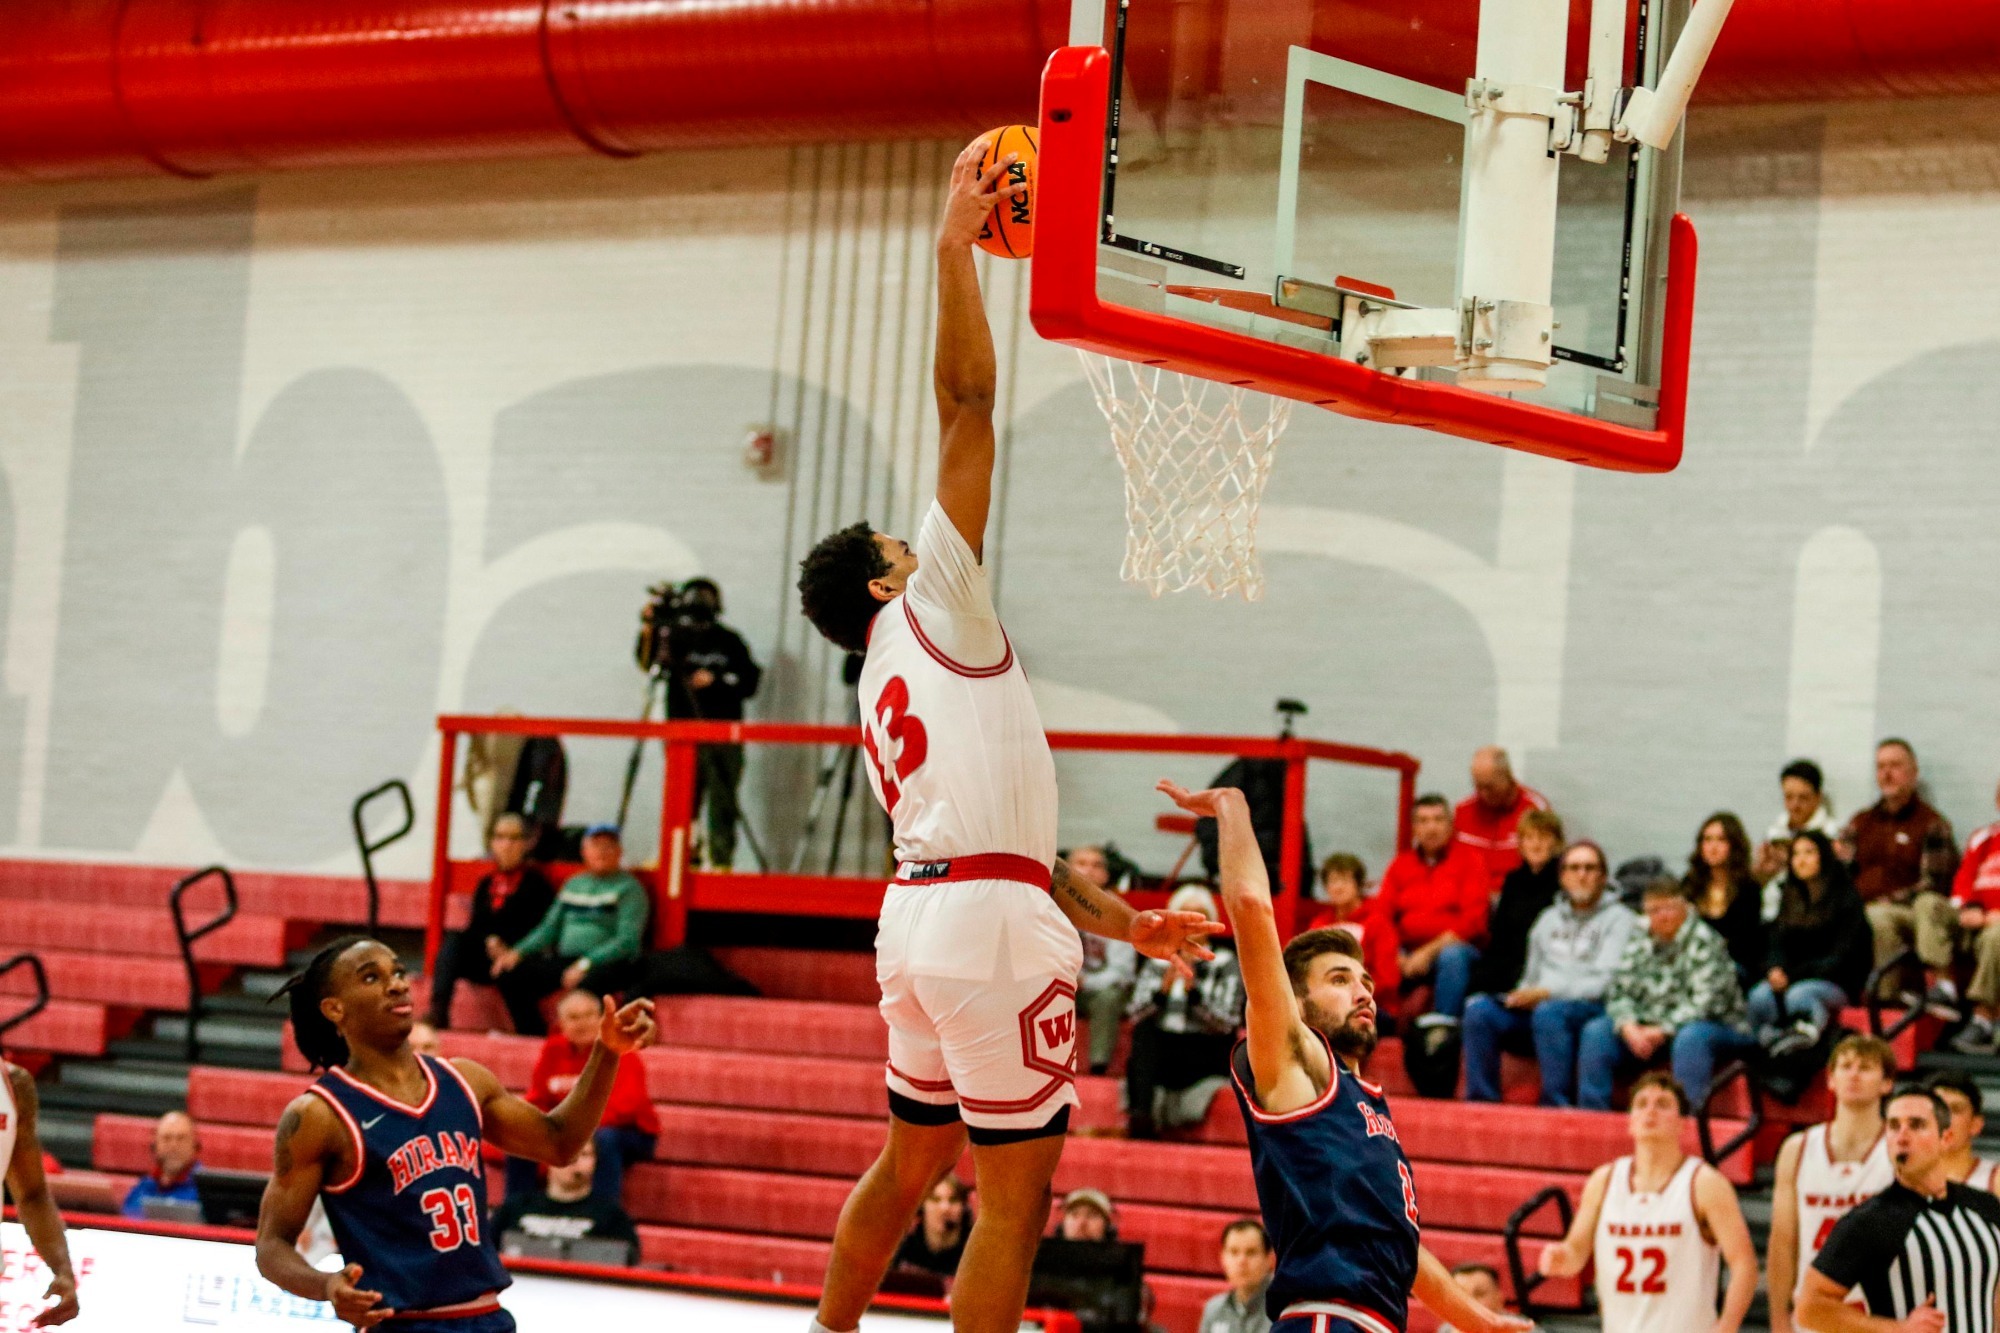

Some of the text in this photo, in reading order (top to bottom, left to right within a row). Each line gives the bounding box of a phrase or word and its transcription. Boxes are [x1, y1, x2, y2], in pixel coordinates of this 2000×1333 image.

[387, 1131, 481, 1195] HIRAM
[420, 1183, 481, 1252] 33
[1615, 1246, 1667, 1293] 22
